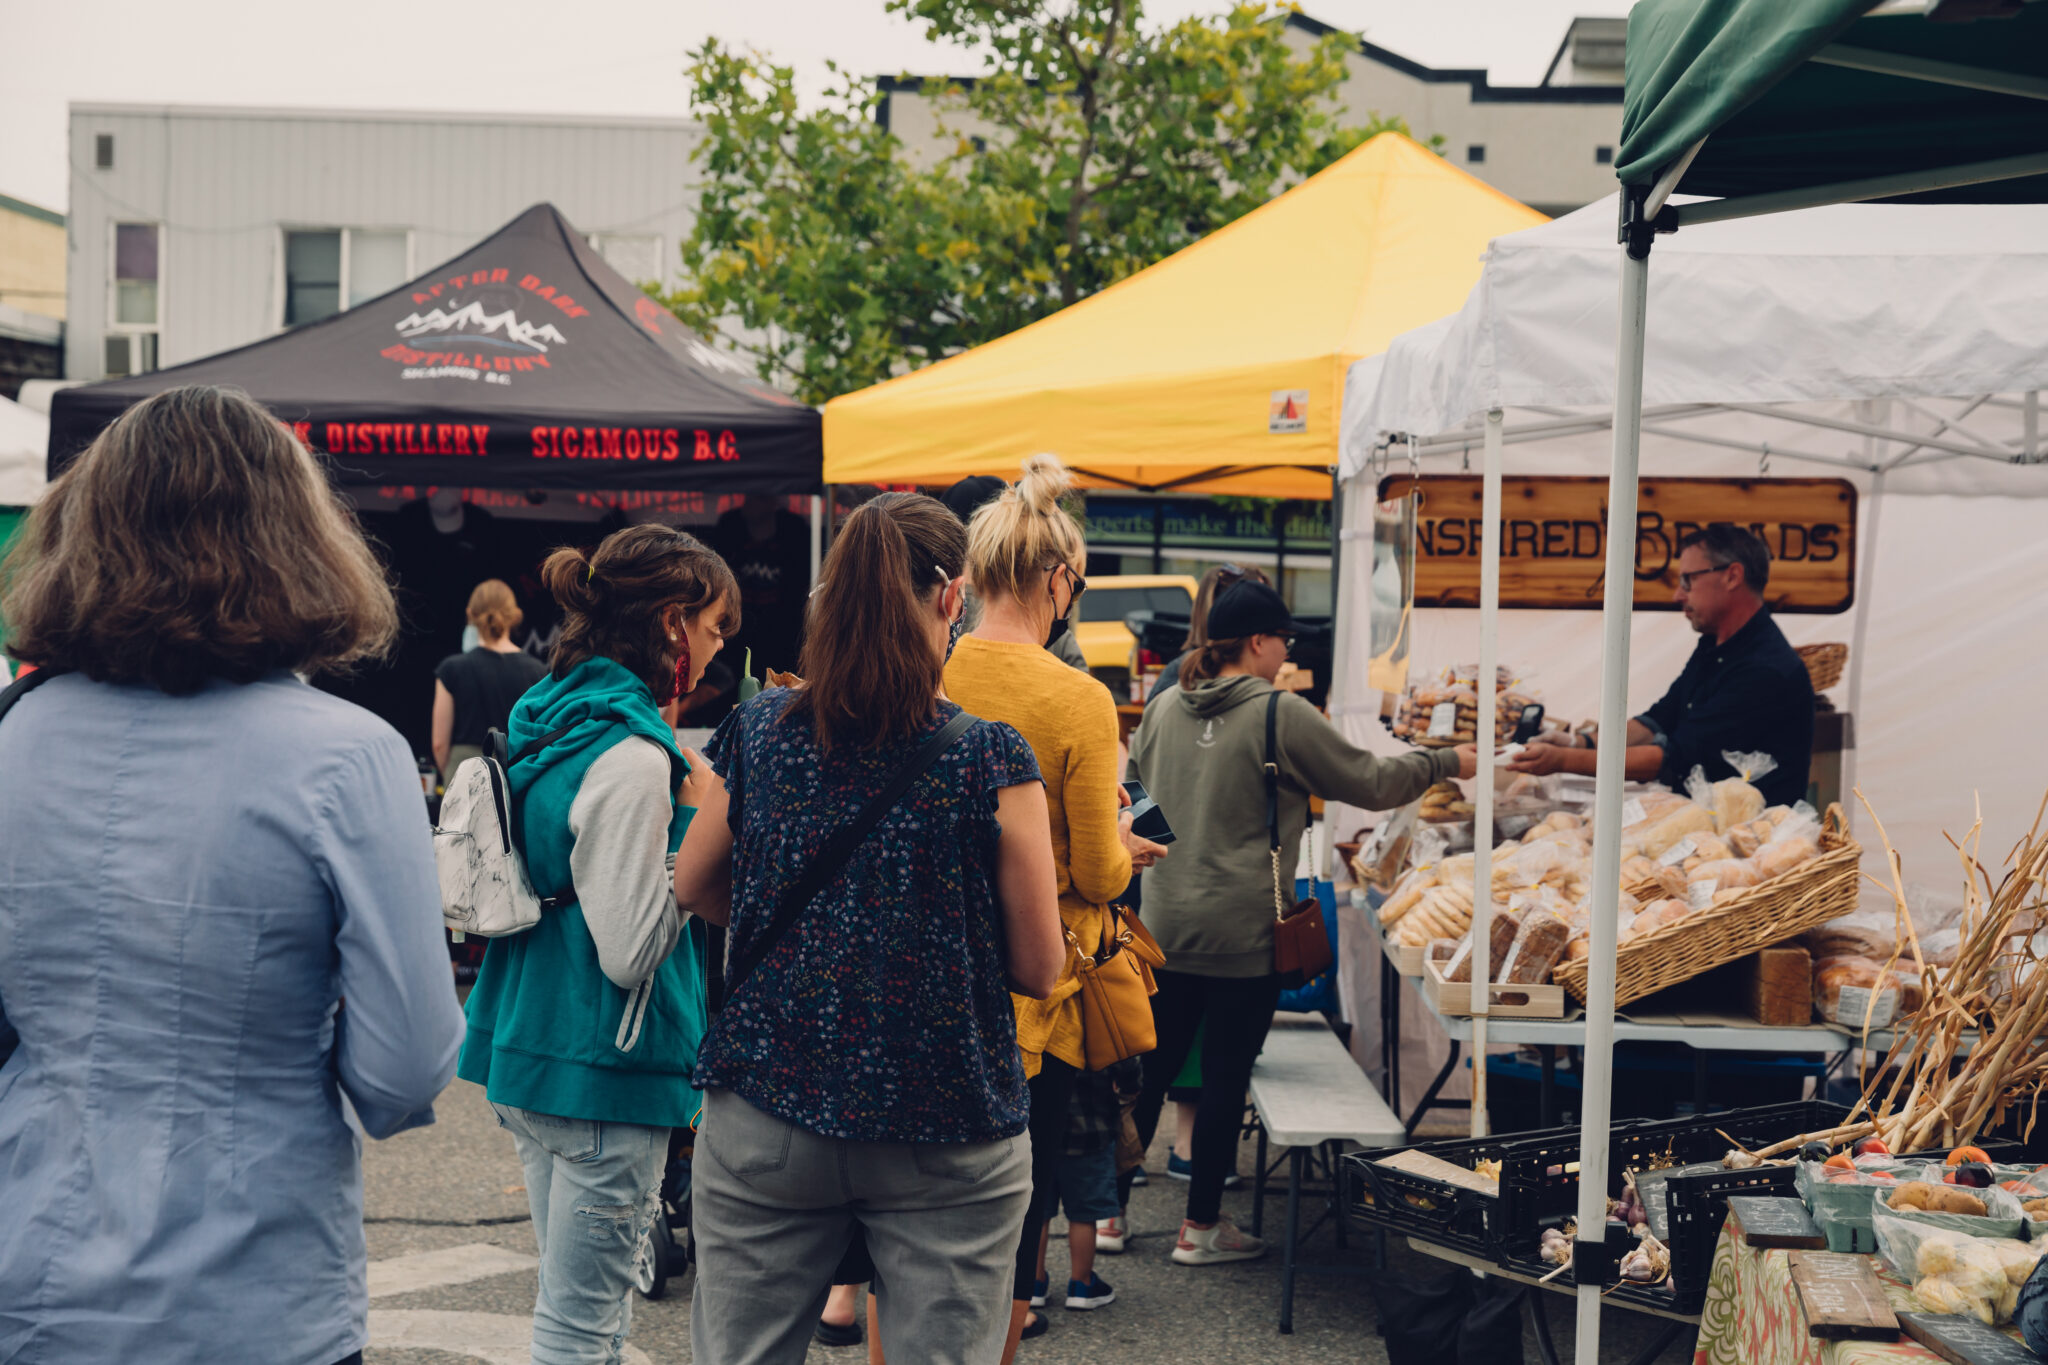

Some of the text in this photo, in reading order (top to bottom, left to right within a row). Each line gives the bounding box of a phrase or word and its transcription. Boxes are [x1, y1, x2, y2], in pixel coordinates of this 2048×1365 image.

[411, 268, 509, 305] AFTER
[519, 273, 590, 319] DARK
[326, 422, 490, 456] DISTILLERY
[531, 425, 681, 461] SICAMOUS
